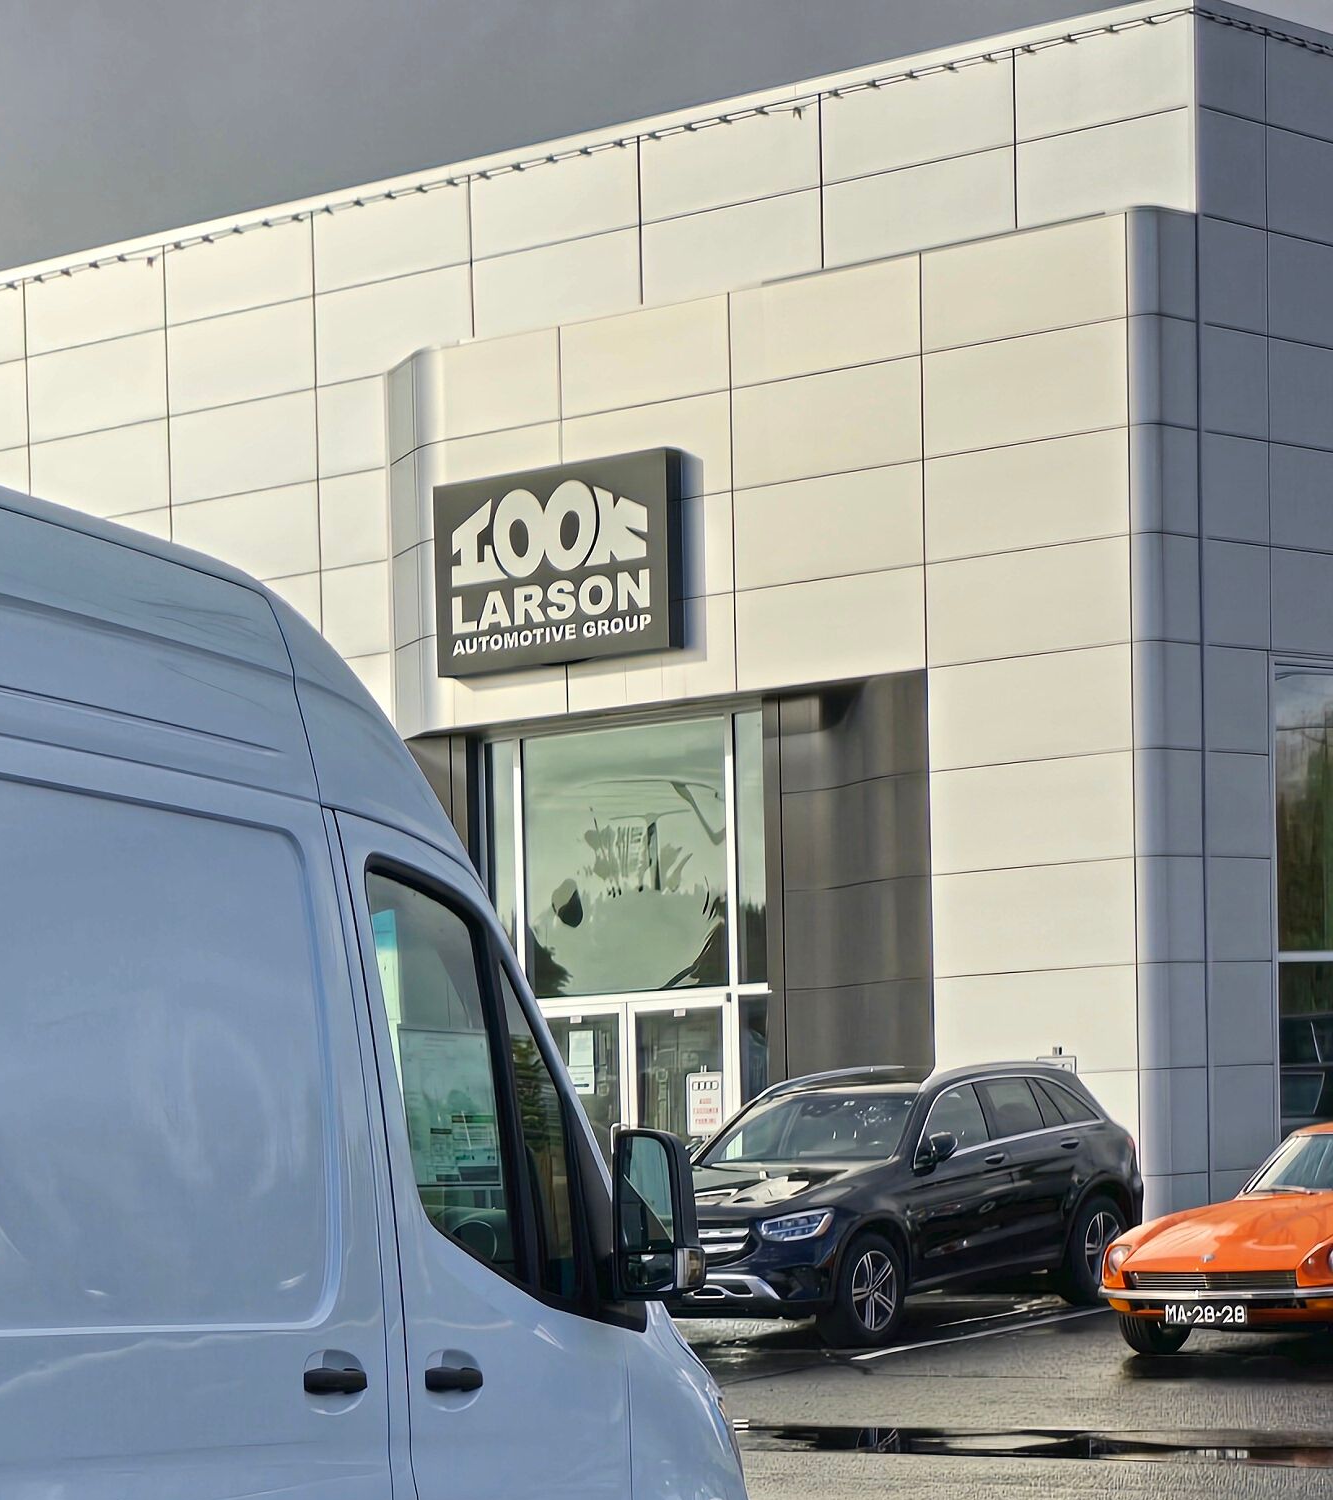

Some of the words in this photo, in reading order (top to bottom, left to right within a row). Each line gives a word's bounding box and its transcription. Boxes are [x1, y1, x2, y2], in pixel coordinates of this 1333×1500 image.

[451, 568, 651, 636] LARSON
[452, 623, 577, 657] AUTOMOTIVE
[582, 613, 652, 639] GROUP
